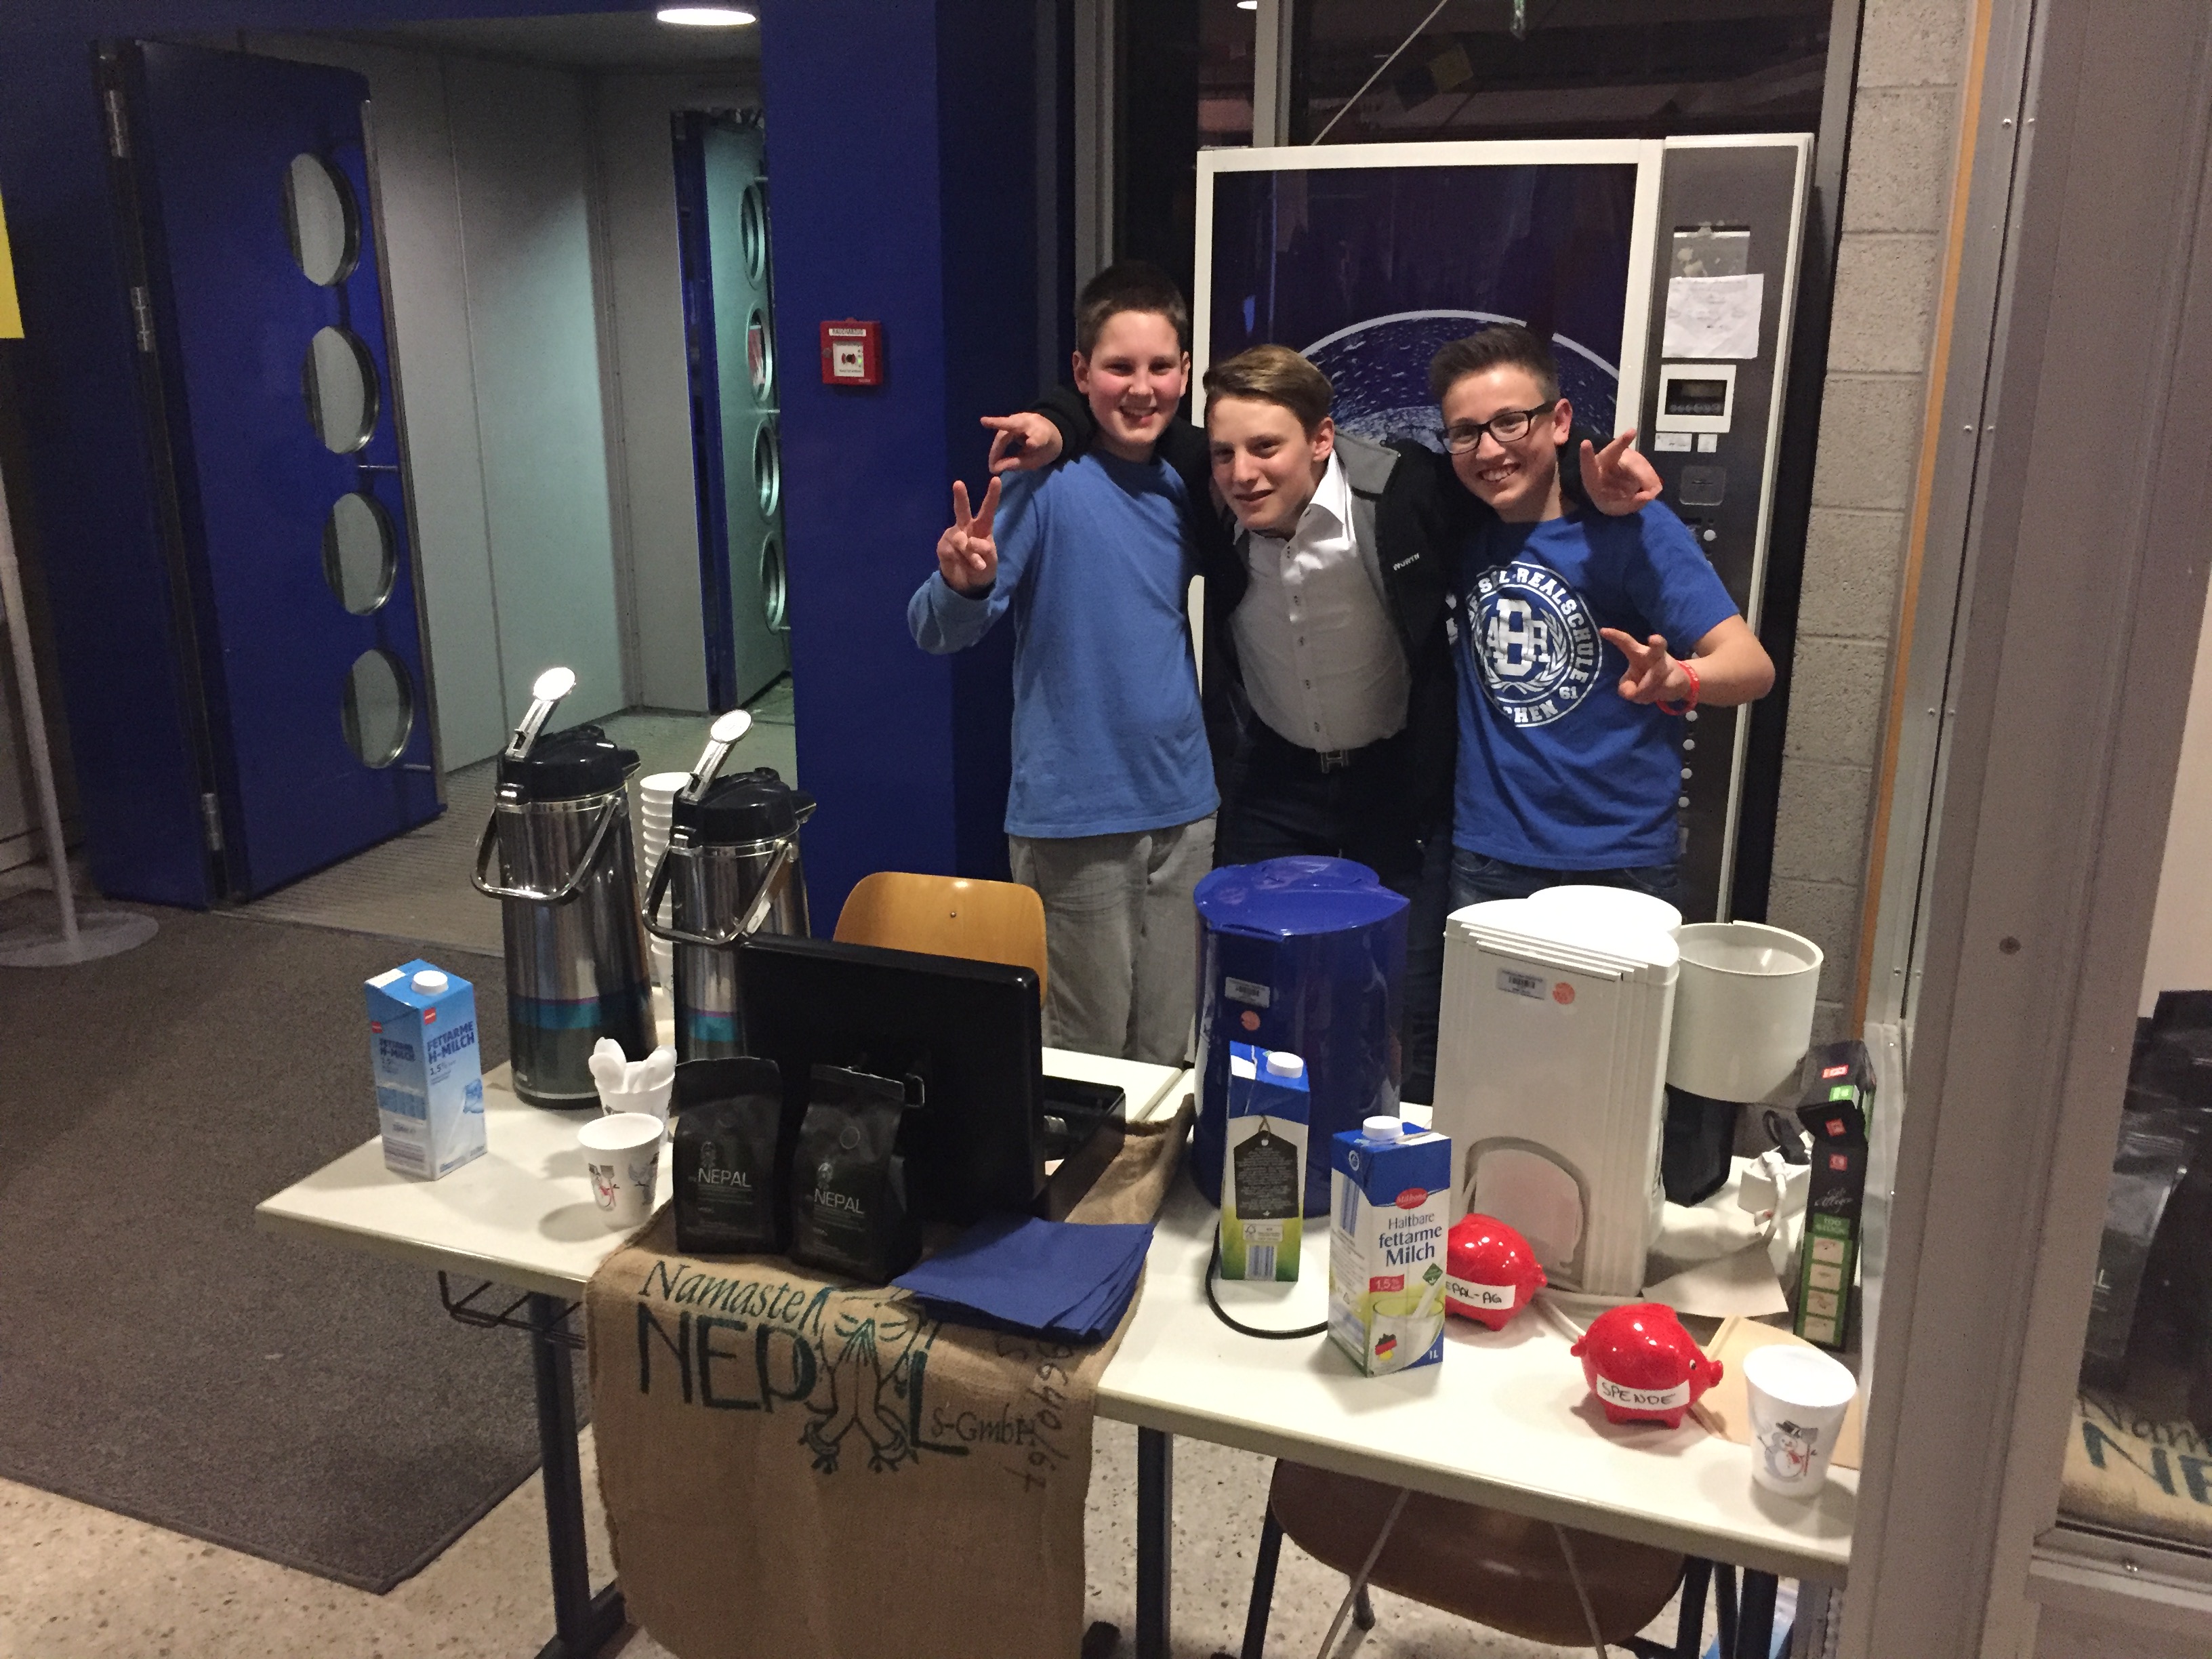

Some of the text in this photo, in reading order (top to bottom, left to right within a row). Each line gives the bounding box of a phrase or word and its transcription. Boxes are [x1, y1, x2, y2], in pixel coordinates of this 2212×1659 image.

[1559, 686, 1578, 700] 61
[426, 1021, 474, 1052] FETTARME
[427, 1031, 474, 1065] H-MILCH
[698, 1168, 752, 1187] NEPAL
[814, 1188, 865, 1214] NEPAL
[1388, 1213, 1435, 1230] Haltbare
[1378, 1225, 1443, 1249] fettarme
[1386, 1242, 1435, 1267] Milch
[638, 1259, 806, 1324] Namaste
